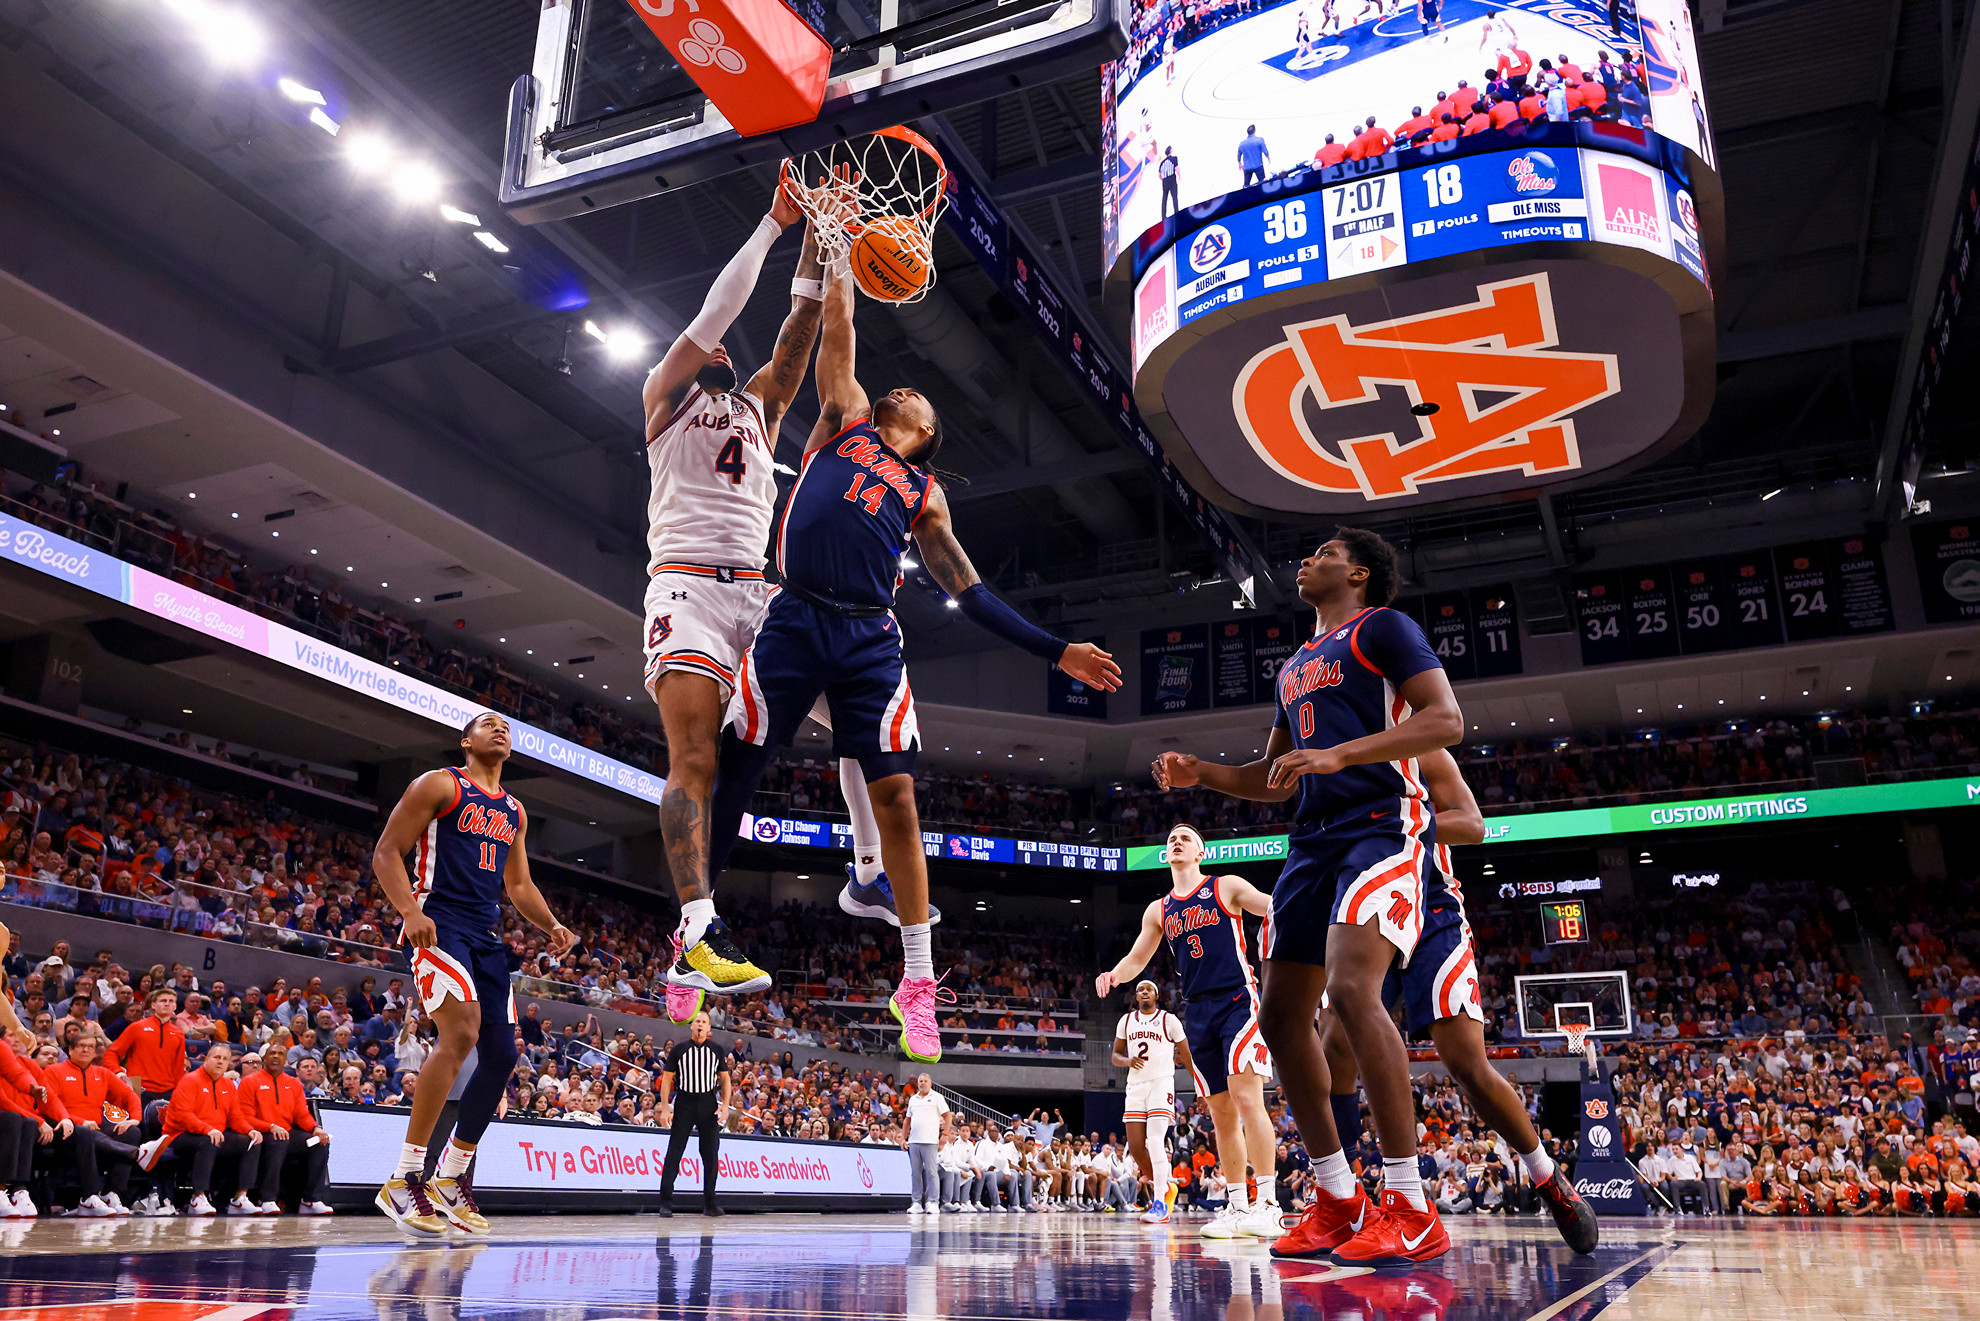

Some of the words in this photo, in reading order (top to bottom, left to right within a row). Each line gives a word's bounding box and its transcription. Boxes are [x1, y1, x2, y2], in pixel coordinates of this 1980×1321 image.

[1508, 158, 1533, 176] Ole
[1422, 164, 1462, 208] 18
[1517, 173, 1555, 192] Miss
[1332, 178, 1386, 217] 7:07
[1513, 203, 1532, 216] OLE
[1534, 202, 1561, 214] MISS
[1263, 200, 1307, 244] 36
[1358, 217, 1385, 233] HALF
[1420, 223, 1427, 235] 7
[1437, 213, 1479, 230] FOULS
[1612, 206, 1659, 234] ALFA
[1502, 226, 1562, 240] TIMEOUTS
[1568, 225, 1575, 236] 4
[1606, 222, 1661, 243] INSURANCE
[1258, 254, 1295, 269] FOULS
[1304, 247, 1312, 259] 5
[1361, 245, 1375, 260] 18
[868, 259, 910, 297] Wilson
[1195, 271, 1226, 293] AUBURN
[1183, 293, 1227, 319] TIMEOUTS
[1037, 300, 1060, 338] 2022
[1089, 368, 1110, 400] 2019
[683, 412, 760, 452] AUBRN
[715, 435, 746, 485] 4
[837, 435, 881, 468] Ole
[870, 453, 921, 508] Miss
[843, 473, 888, 516] 14
[14, 530, 90, 578] Beach
[1840, 560, 1875, 572] CIAMPI
[1738, 586, 1766, 597] JONES
[1784, 578, 1825, 591] BONNER
[1633, 598, 1667, 609] BOLTON
[1690, 592, 1710, 601] ORR
[1789, 591, 1828, 617] 24
[153, 592, 202, 622] Myrtle
[204, 612, 245, 640] Beach
[1581, 604, 1621, 616] JACKSON
[1687, 604, 1720, 629] 50
[1739, 598, 1768, 623] 21
[1434, 623, 1464, 634] PERSON
[1480, 617, 1511, 628] PERSON
[1586, 616, 1620, 641] 34
[1636, 611, 1668, 635] 25
[1166, 643, 1204, 651] BASKETBALL
[1221, 643, 1244, 652] SMITH
[1255, 645, 1293, 656] FREDERICK
[1436, 635, 1466, 657] 45
[1486, 630, 1508, 653] 11
[52, 658, 82, 683] 102
[1163, 667, 1189, 677] FINAL
[1299, 654, 1344, 698] Miss
[295, 640, 474, 724] VisitMyrtleBeach.com
[1161, 676, 1188, 687] FOUR
[1067, 695, 1089, 705] 2022
[1164, 700, 1186, 709] 2019
[1300, 701, 1315, 739] 0
[518, 729, 545, 754] YOU
[548, 743, 586, 770] CAN'T
[589, 758, 615, 781] BEAT
[617, 768, 637, 790] The
[637, 776, 663, 800] Beac
[1650, 804, 1724, 825] CUSTOM
[1728, 797, 1807, 819] FITTINGS
[457, 803, 487, 834] Ole
[485, 809, 517, 845] Miss
[784, 821, 792, 831] 31
[795, 821, 820, 834] Chaney
[781, 833, 810, 845] Johnson
[839, 836, 846, 848] 2
[973, 839, 981, 848] 14
[984, 838, 994, 849] Dre
[1022, 842, 1032, 850] PTS
[1220, 840, 1283, 858] FITTINGS
[479, 842, 497, 872] 11
[926, 844, 940, 856] 0/0
[971, 849, 990, 861] Davis
[1024, 852, 1031, 864] 0
[1046, 854, 1051, 866] 1
[1063, 855, 1076, 868] 0/3
[1084, 857, 1096, 869] 0/2
[1104, 859, 1117, 871] 0/0
[1553, 904, 1581, 917] 7:06
[1165, 911, 1183, 940] Ole
[1182, 904, 1220, 932] Miss
[1559, 918, 1581, 939] 18
[1187, 934, 1204, 958] 3
[203, 947, 216, 971] B
[1128, 1031, 1162, 1043] AUBURN
[1137, 1042, 1149, 1061] 2
[519, 1142, 556, 1180] Try
[563, 1152, 576, 1173] a
[580, 1145, 649, 1175] Grilled
[652, 1149, 699, 1184] Scy
[718, 1153, 760, 1179] eluxe
[761, 1155, 831, 1181] Sandwich
[1574, 1178, 1635, 1199] Coca-Cola
